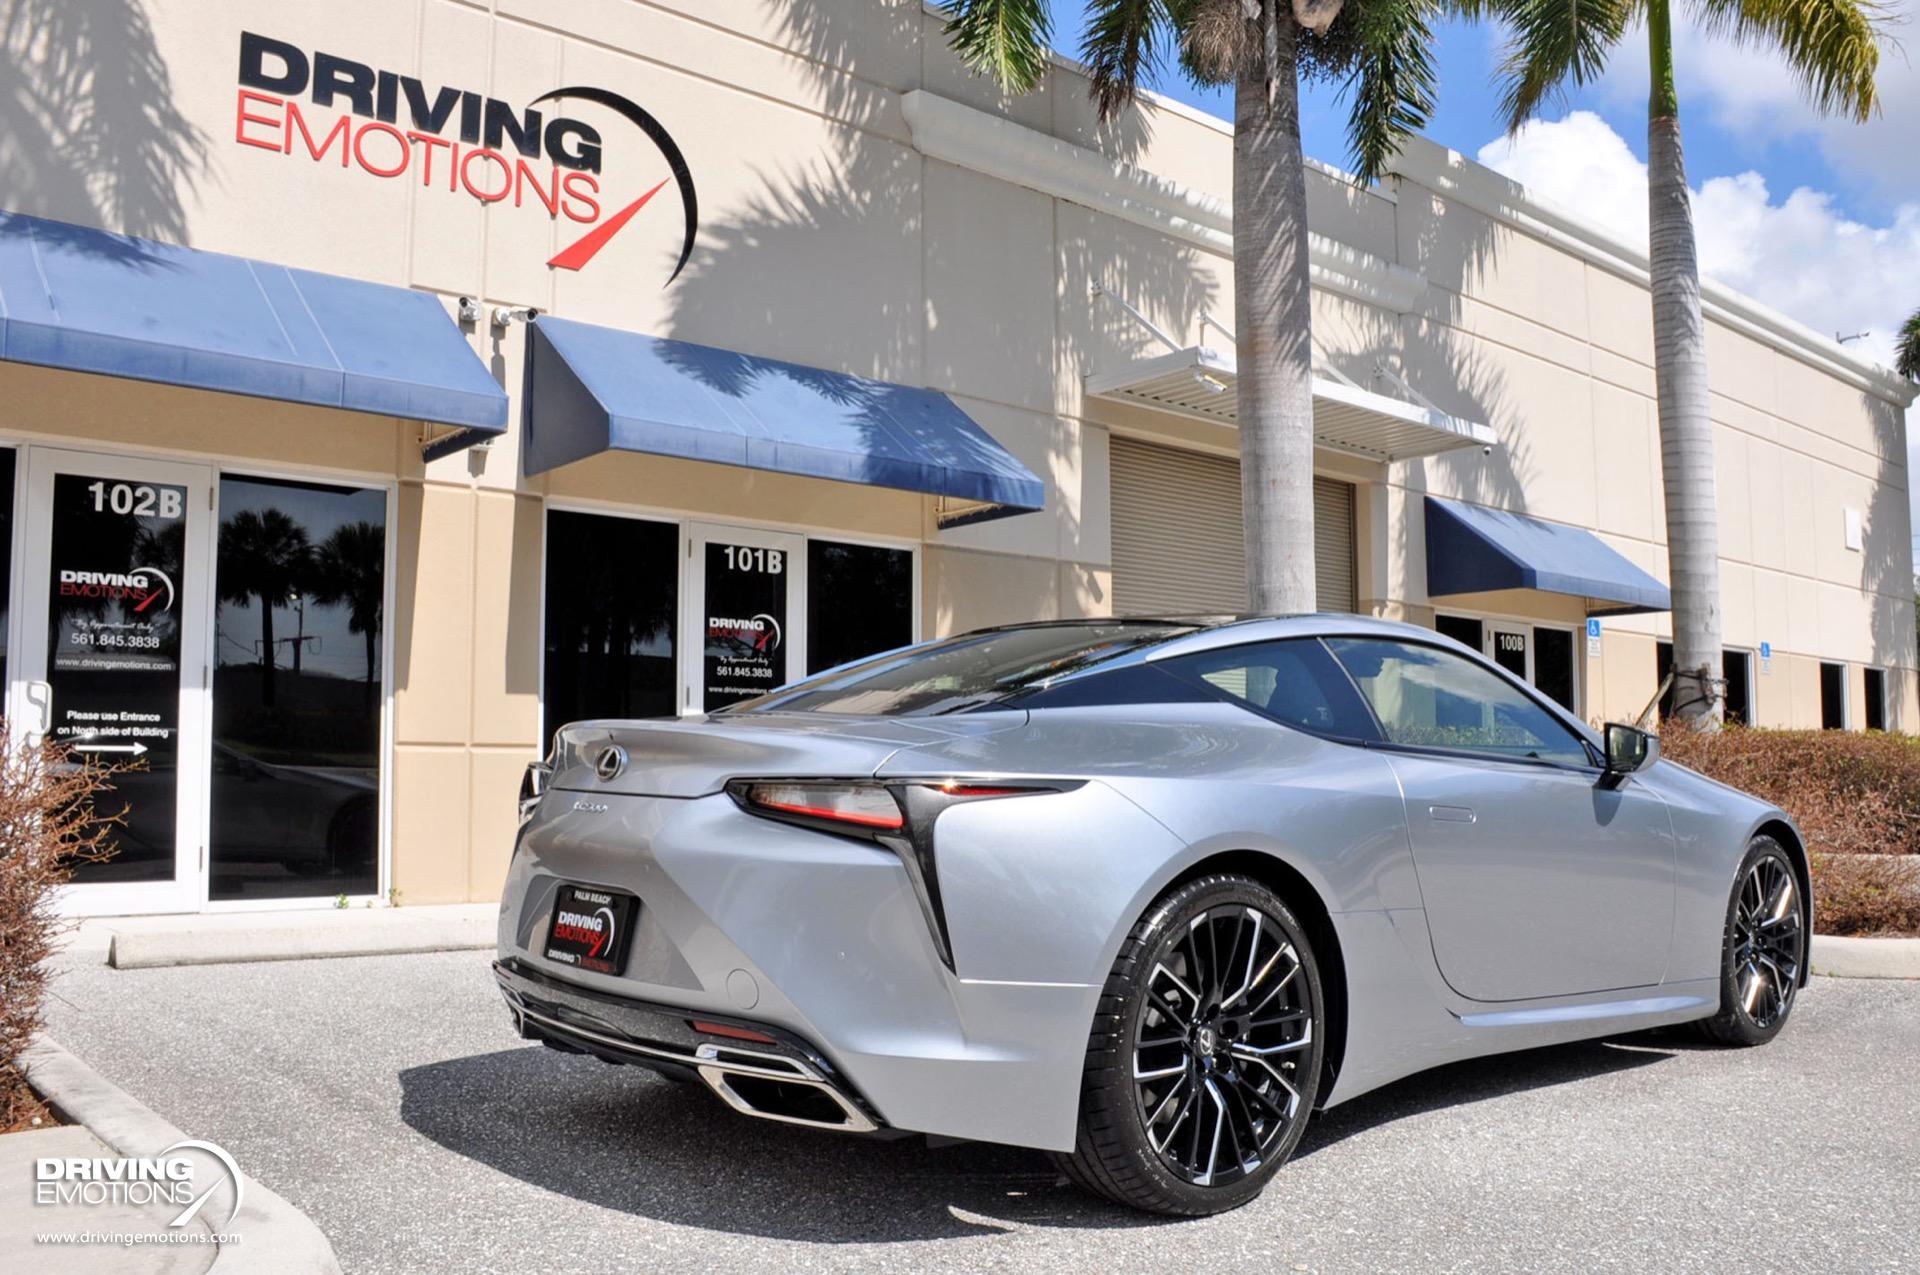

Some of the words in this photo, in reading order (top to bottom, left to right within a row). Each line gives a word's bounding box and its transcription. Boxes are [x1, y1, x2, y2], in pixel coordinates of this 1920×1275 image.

[239, 31, 602, 174] DRIVING
[236, 89, 601, 224] EMOTIONS
[88, 481, 182, 519] 102B
[724, 546, 782, 574] 101B
[61, 570, 148, 588] DRIVING
[60, 583, 148, 600] EMOTIONS
[709, 617, 765, 631] DRIVING
[71, 632, 160, 649] 561.845.3838
[1500, 634, 1524, 652] 100B
[56, 659, 172, 670] www.drivingemotions.com
[716, 665, 773, 678] 561.845.3838
[66, 710, 99, 721] Please
[101, 713, 118, 721] use
[120, 711, 161, 722] Entrance
[57, 727, 70, 735] on
[72, 725, 99, 737] North
[100, 726, 119, 736] side
[121, 727, 131, 736] of
[132, 727, 169, 739] Building
[574, 890, 590, 901] PALM
[590, 892, 612, 905] BEACH
[558, 911, 603, 932] DRIVING
[555, 924, 603, 946] EMOTIONS
[548, 949, 575, 963] DRIVING
